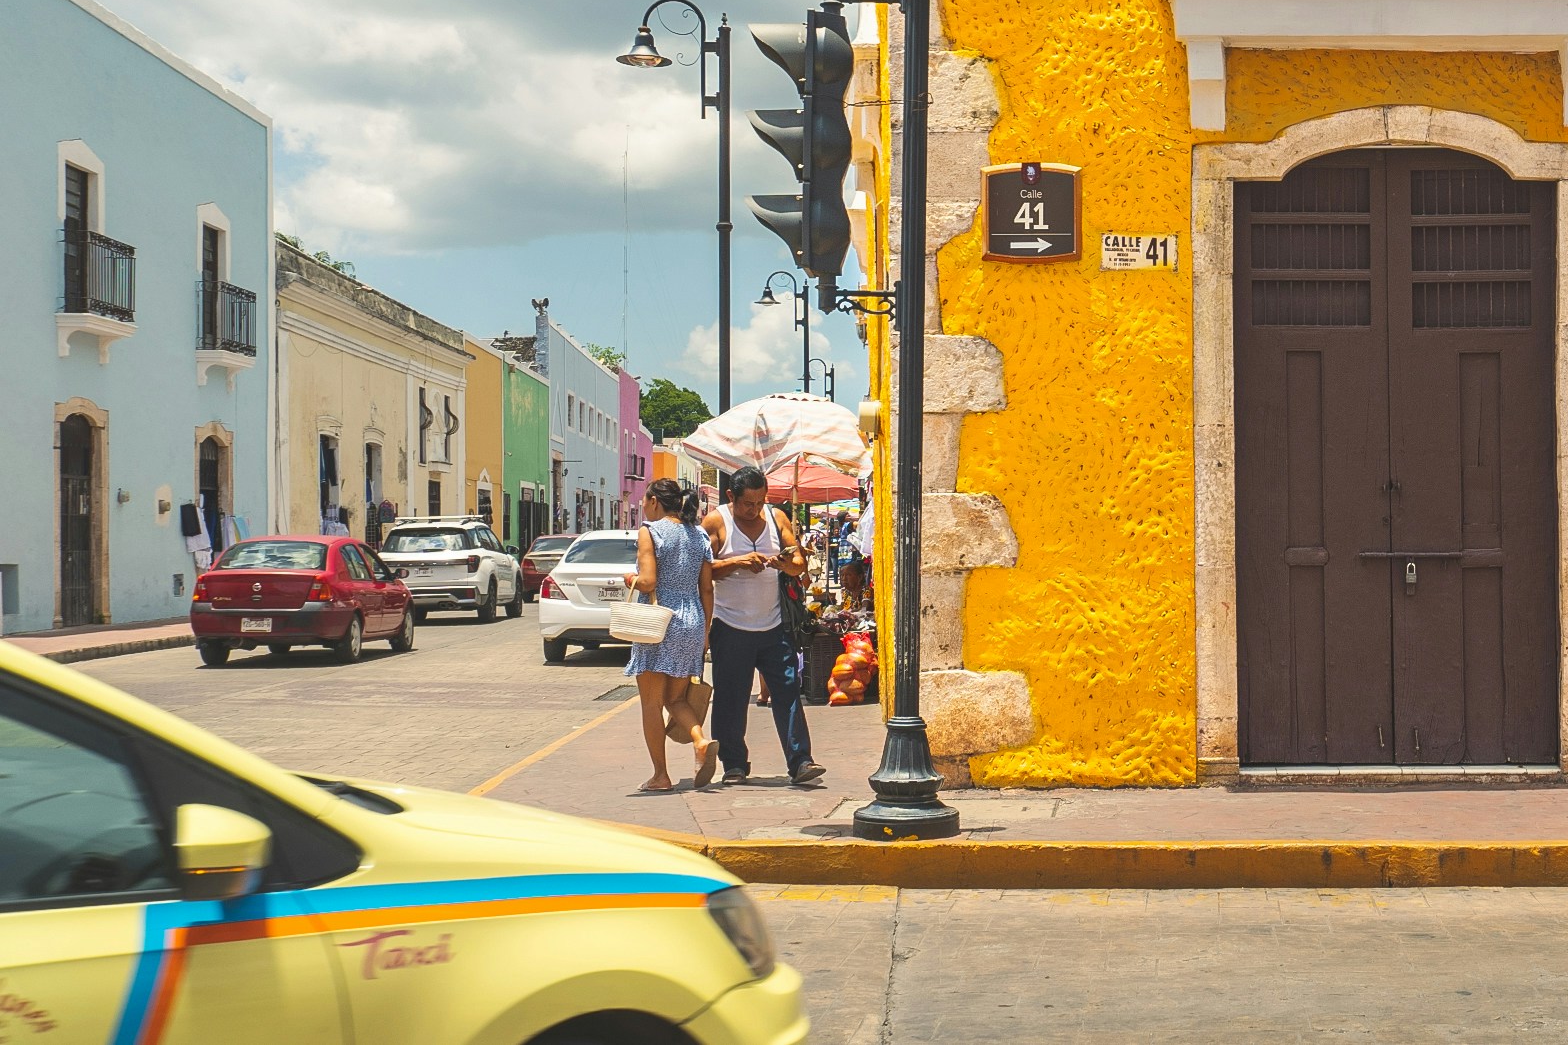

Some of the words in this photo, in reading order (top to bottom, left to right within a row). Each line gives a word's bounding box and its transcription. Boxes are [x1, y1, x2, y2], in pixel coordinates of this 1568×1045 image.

[1020, 189, 1043, 199] Calle
[1013, 202, 1049, 230] 41
[1104, 236, 1141, 247] CALLE
[1146, 237, 1168, 266] 41
[332, 929, 456, 980] Taxi
